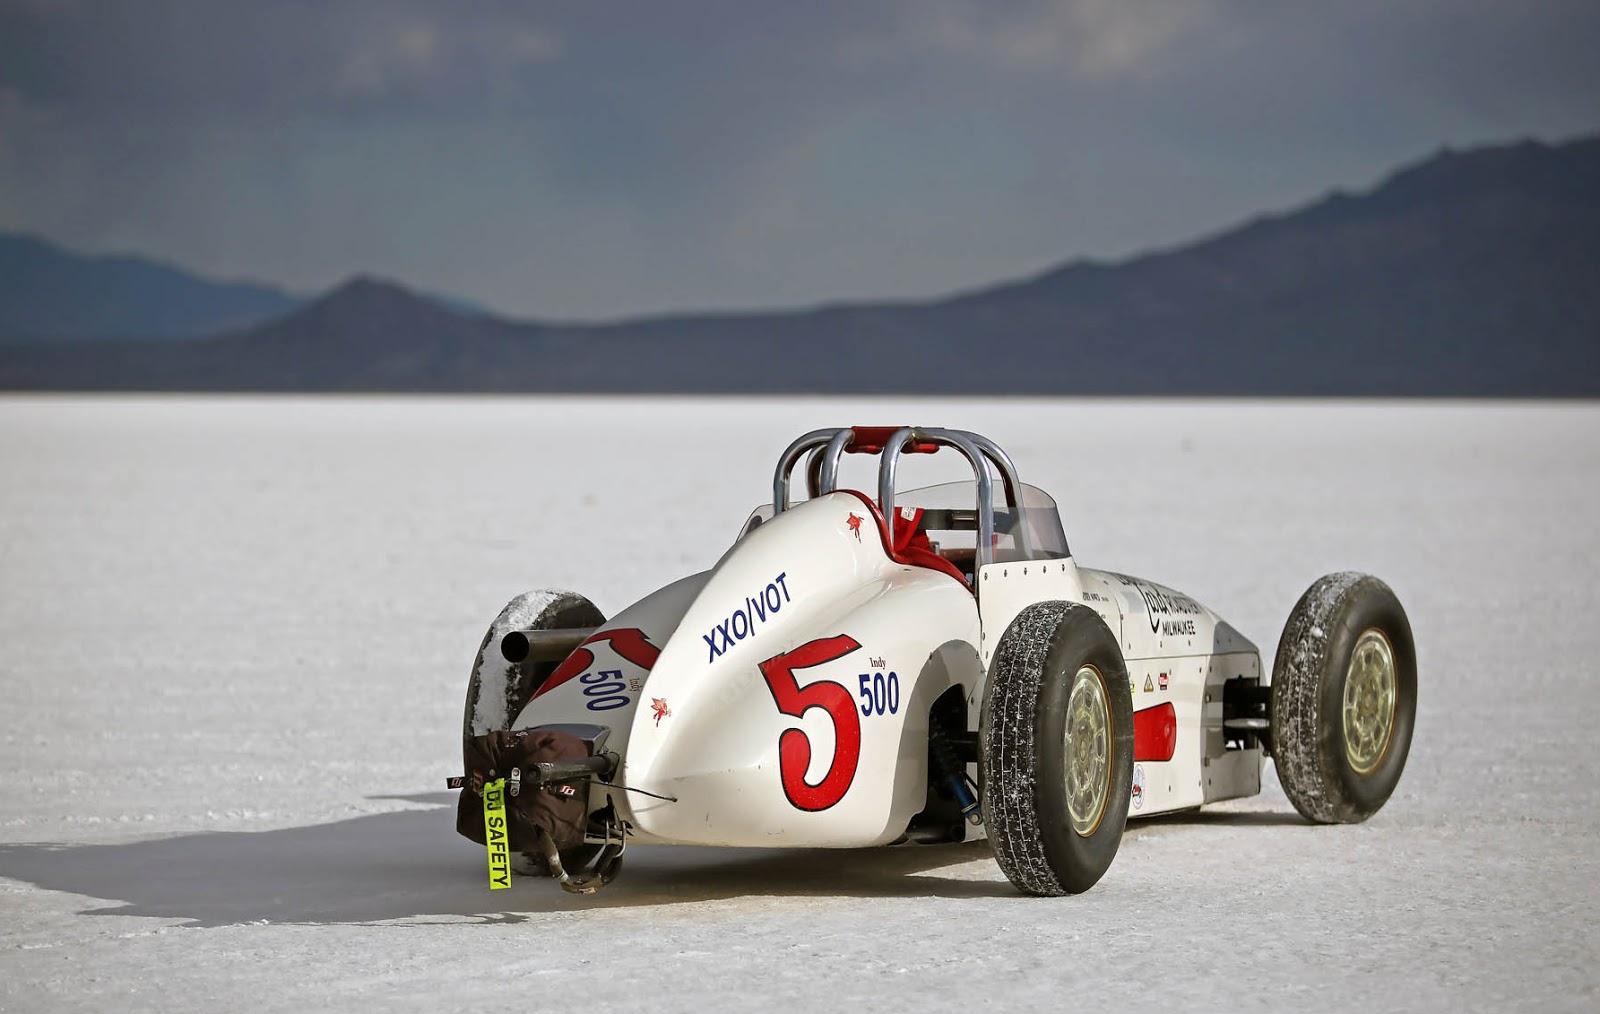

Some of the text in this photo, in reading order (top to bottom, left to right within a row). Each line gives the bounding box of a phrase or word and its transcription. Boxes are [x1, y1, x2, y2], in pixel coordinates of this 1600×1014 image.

[703, 572, 791, 664] XXO/VOT
[1162, 620, 1196, 636] MILWAUKEE
[869, 656, 886, 670] Indy
[579, 670, 631, 711] 500
[858, 671, 900, 717] 500
[757, 633, 863, 812] 5
[486, 789, 508, 887] DJ SAFETY
